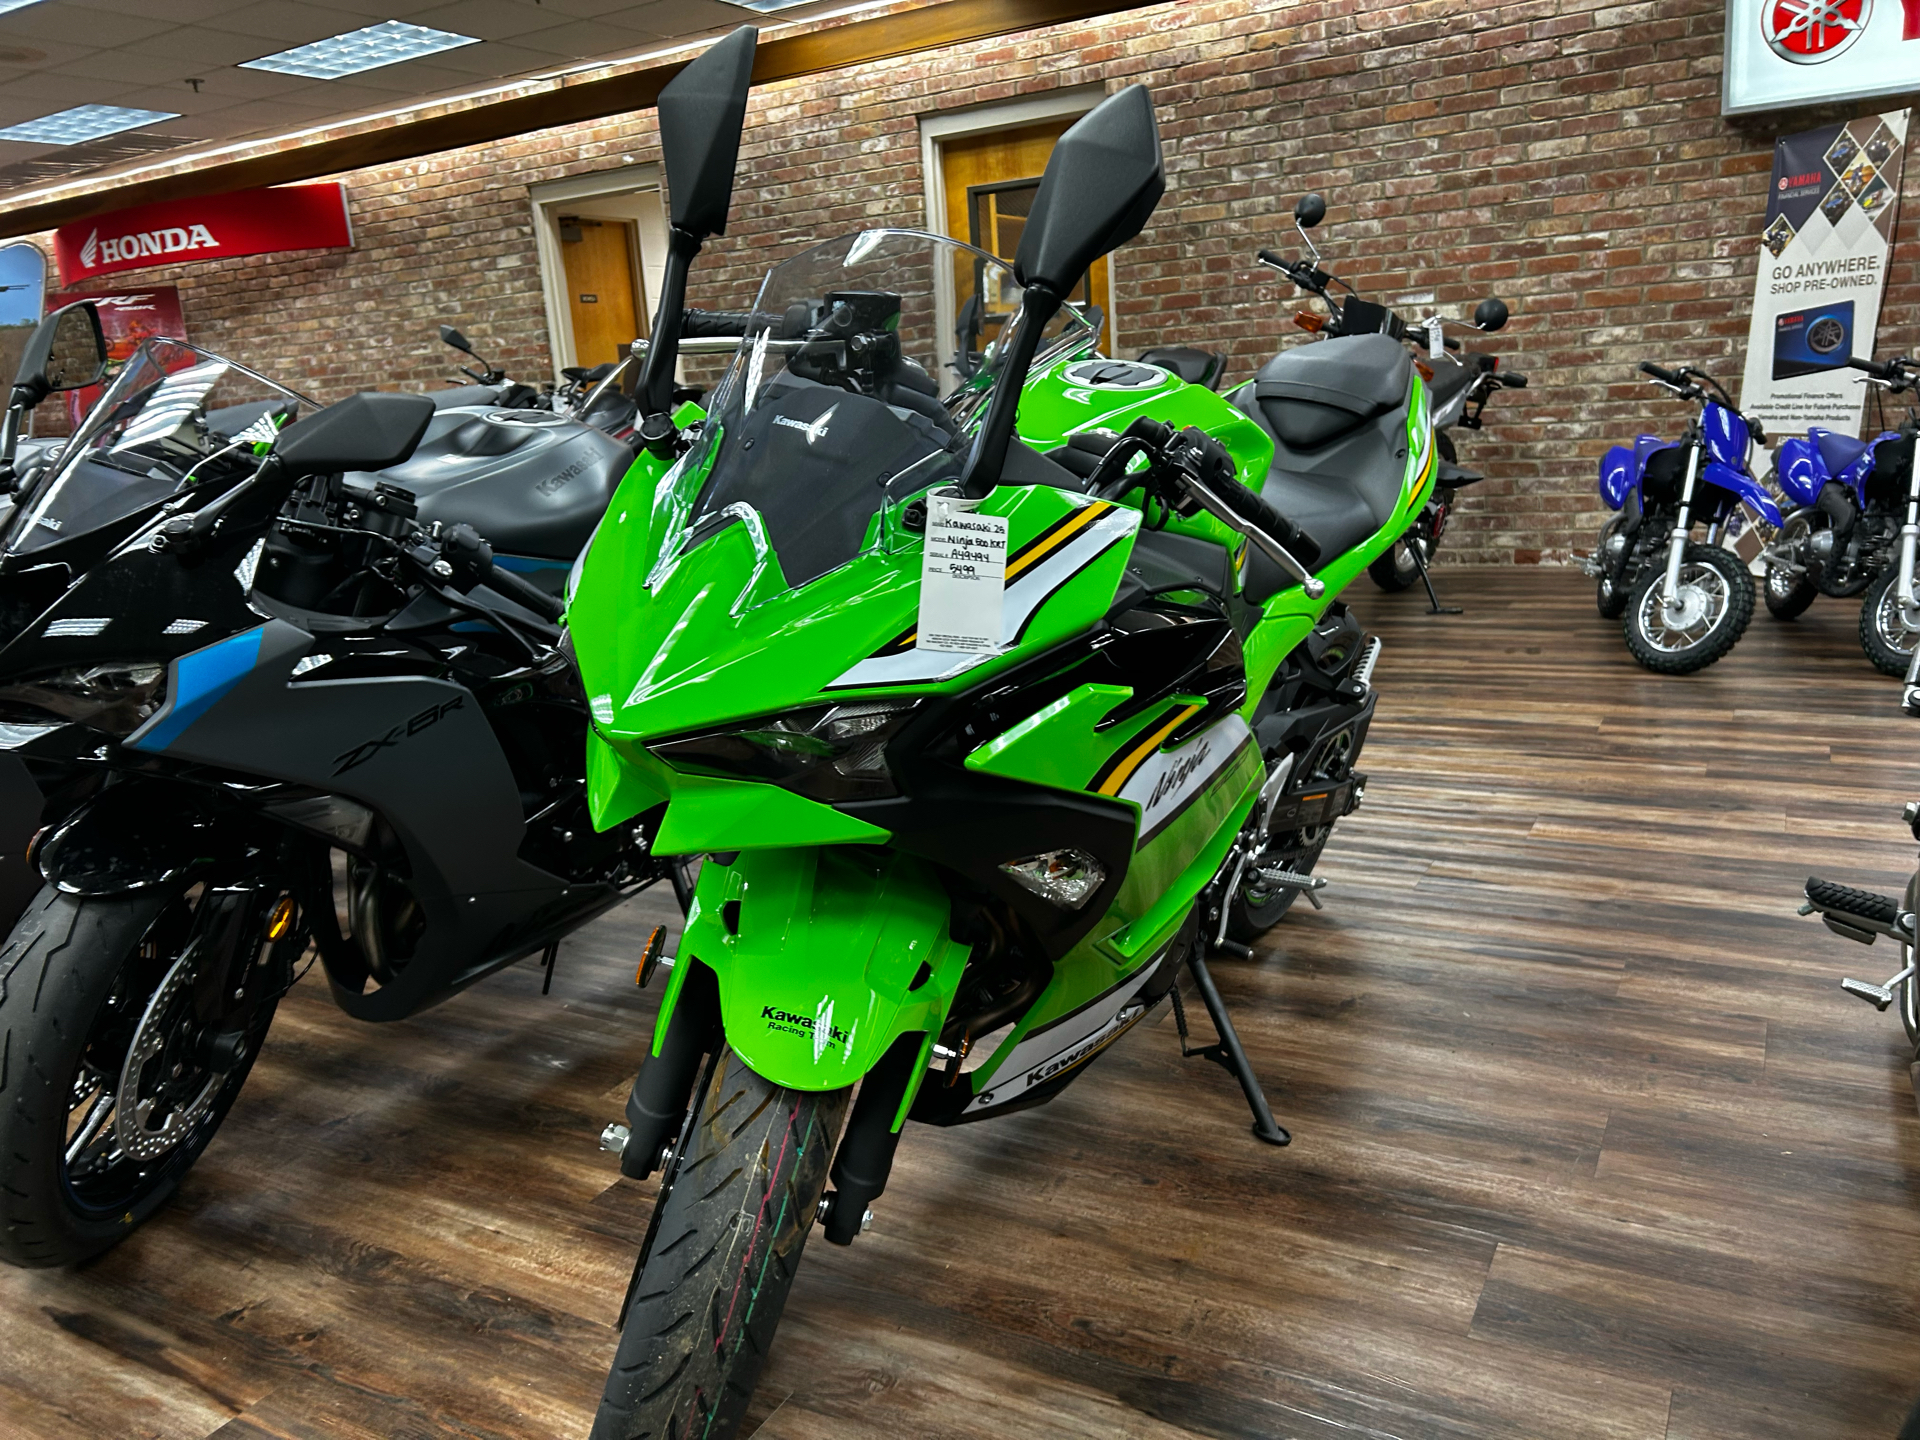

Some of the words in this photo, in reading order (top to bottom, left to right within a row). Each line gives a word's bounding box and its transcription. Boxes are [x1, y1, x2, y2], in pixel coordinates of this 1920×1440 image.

[1788, 171, 1821, 188] YAMAHA
[99, 224, 220, 264] HONDA
[1772, 265, 1793, 280] GO
[1795, 255, 1881, 278] ANYWHERE.
[1770, 281, 1802, 294] SHOP
[1803, 274, 1877, 292] PRE-OWNED.
[1804, 392, 1825, 400] Finance
[772, 414, 829, 437] Kawaski
[534, 446, 605, 498] Kawasaki
[945, 518, 991, 532] Kawasaki
[947, 534, 974, 550] Ninja
[975, 537, 989, 547] 500
[990, 539, 1006, 549] KRT
[951, 548, 989, 563] A49494
[949, 563, 975, 576] 5499
[329, 695, 465, 779] ZX-6R
[1145, 737, 1211, 812] Ninja
[761, 1005, 849, 1044] Kawaki
[767, 1021, 806, 1038] Racing
[809, 1031, 836, 1049] Tm
[1026, 1007, 1140, 1088] Kawasaki
